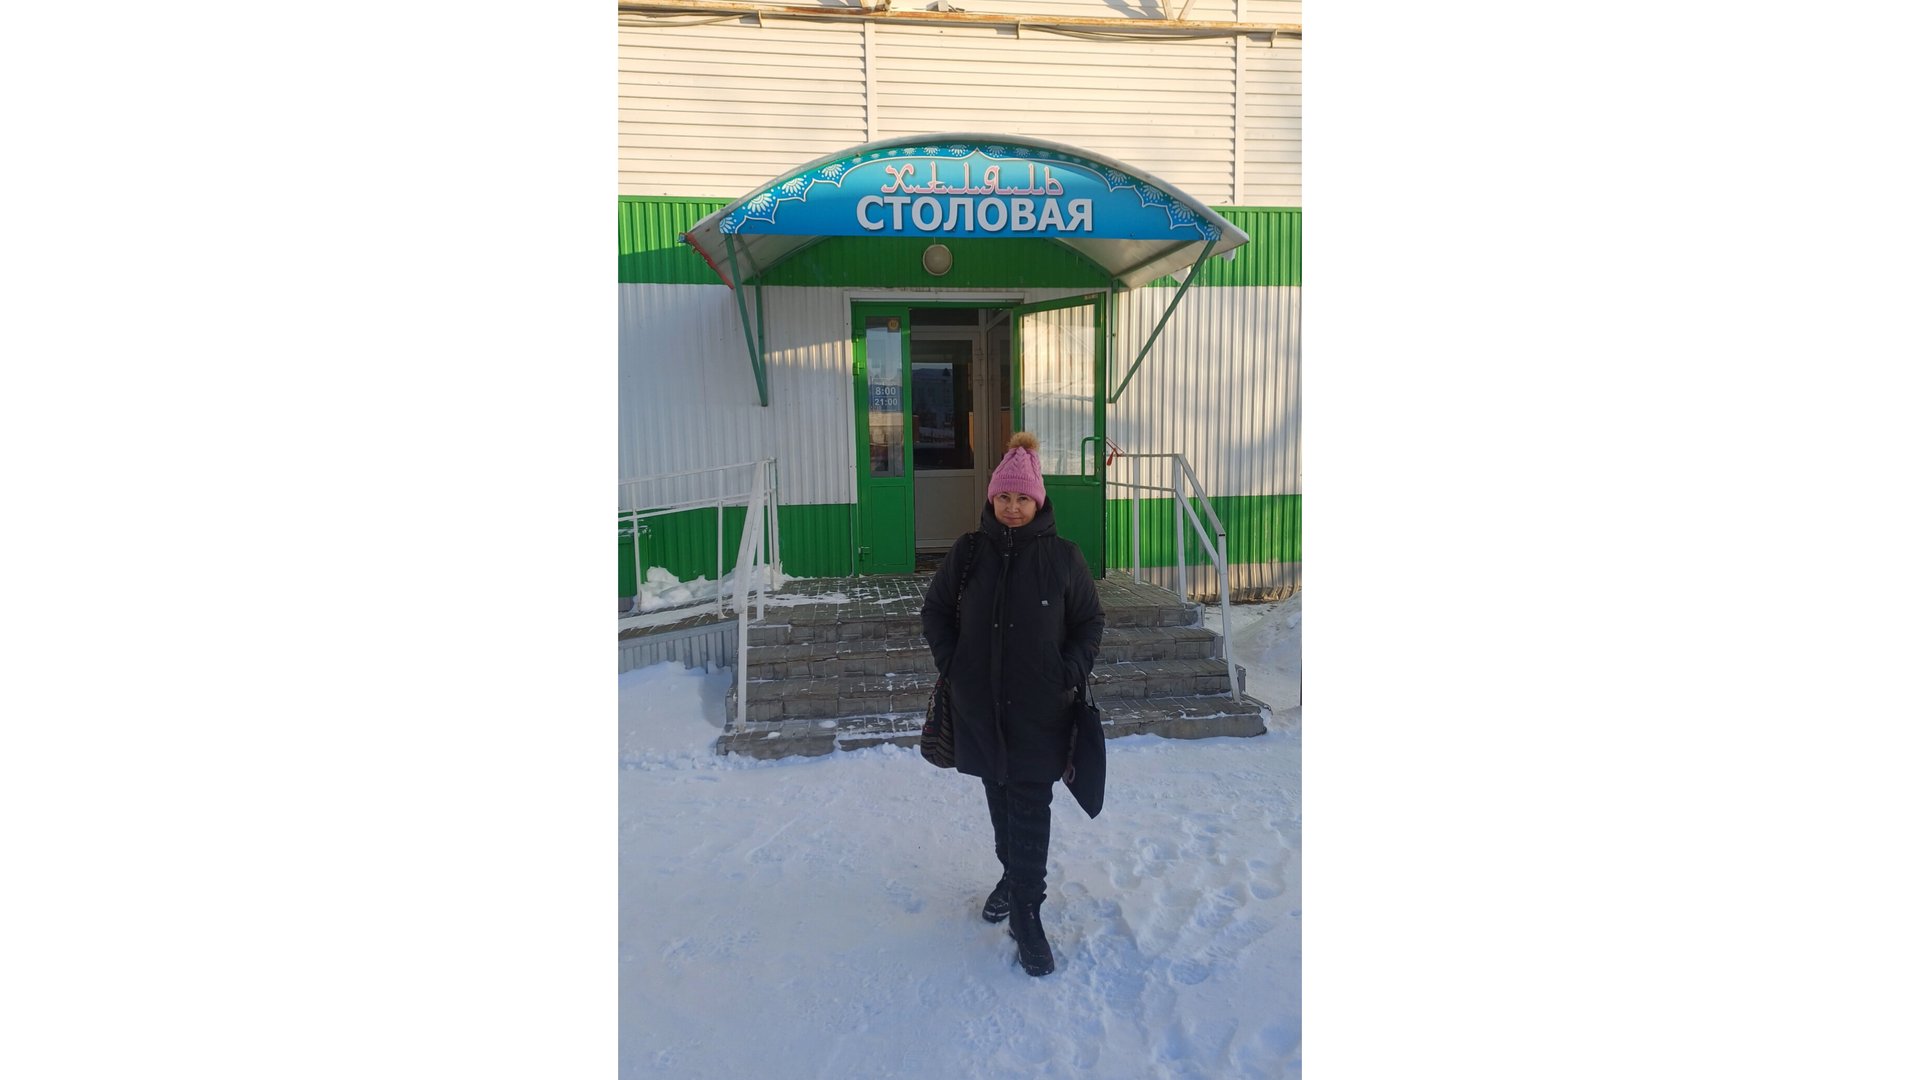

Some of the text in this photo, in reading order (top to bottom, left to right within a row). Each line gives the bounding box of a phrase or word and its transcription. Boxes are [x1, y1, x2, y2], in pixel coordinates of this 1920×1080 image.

[856, 195, 1093, 232] СТОЛОВАЯ
[875, 386, 897, 395] 8:00
[874, 398, 898, 406] 21:00
